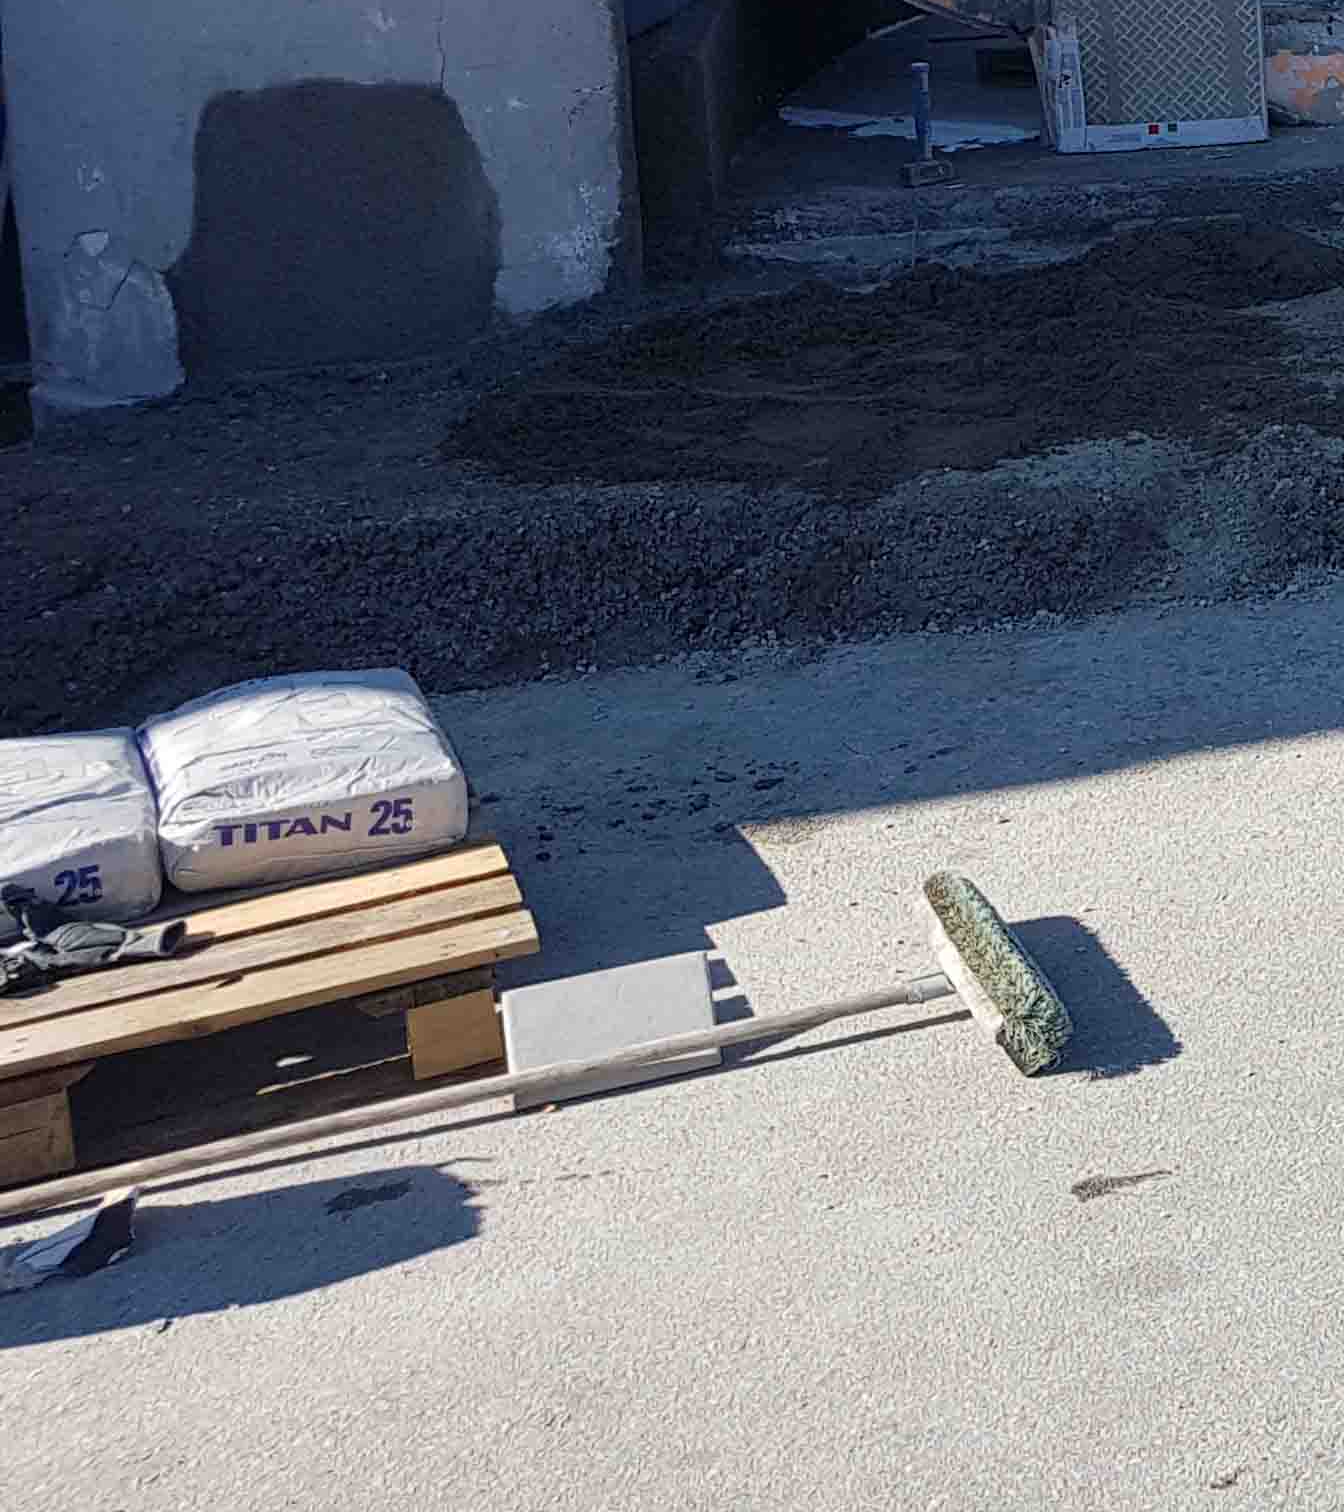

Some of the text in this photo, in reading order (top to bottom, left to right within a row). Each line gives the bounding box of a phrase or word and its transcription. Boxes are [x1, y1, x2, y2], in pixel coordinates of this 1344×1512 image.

[214, 797, 414, 846] TITAN 25
[54, 864, 104, 907] 25
